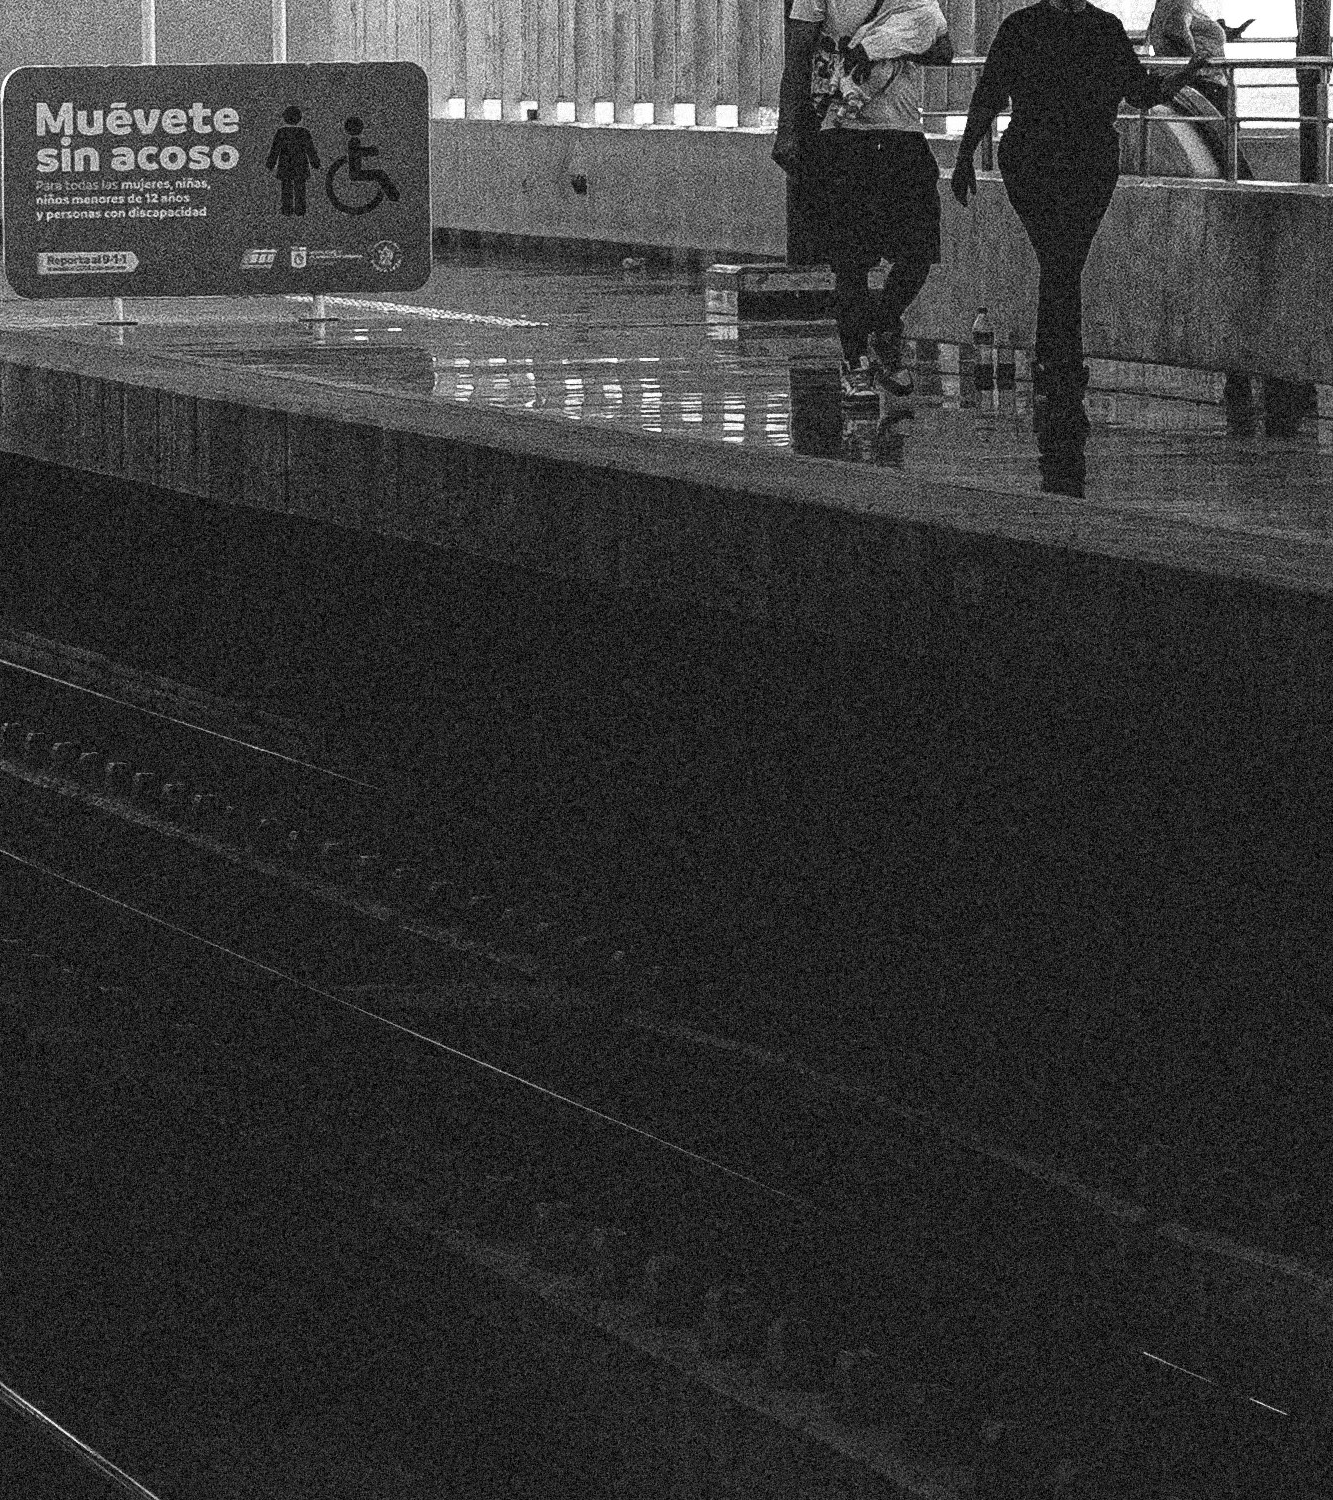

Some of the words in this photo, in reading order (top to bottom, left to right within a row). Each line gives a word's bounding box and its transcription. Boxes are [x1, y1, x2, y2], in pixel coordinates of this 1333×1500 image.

[36, 136, 100, 173] sin
[110, 144, 240, 172] acoso
[35, 180, 63, 192] Para
[65, 180, 99, 191] todas
[101, 179, 118, 191] las
[121, 178, 173, 192] mujeres,
[175, 177, 211, 190] niñas,
[35, 193, 70, 205] niños
[72, 194, 125, 204] menores
[127, 193, 143, 203] de
[145, 192, 159, 203] 12
[161, 191, 191, 203] años
[36, 210, 44, 222] y
[46, 210, 102, 223] personas
[104, 209, 126, 218] con
[128, 206, 207, 220] discapacidad
